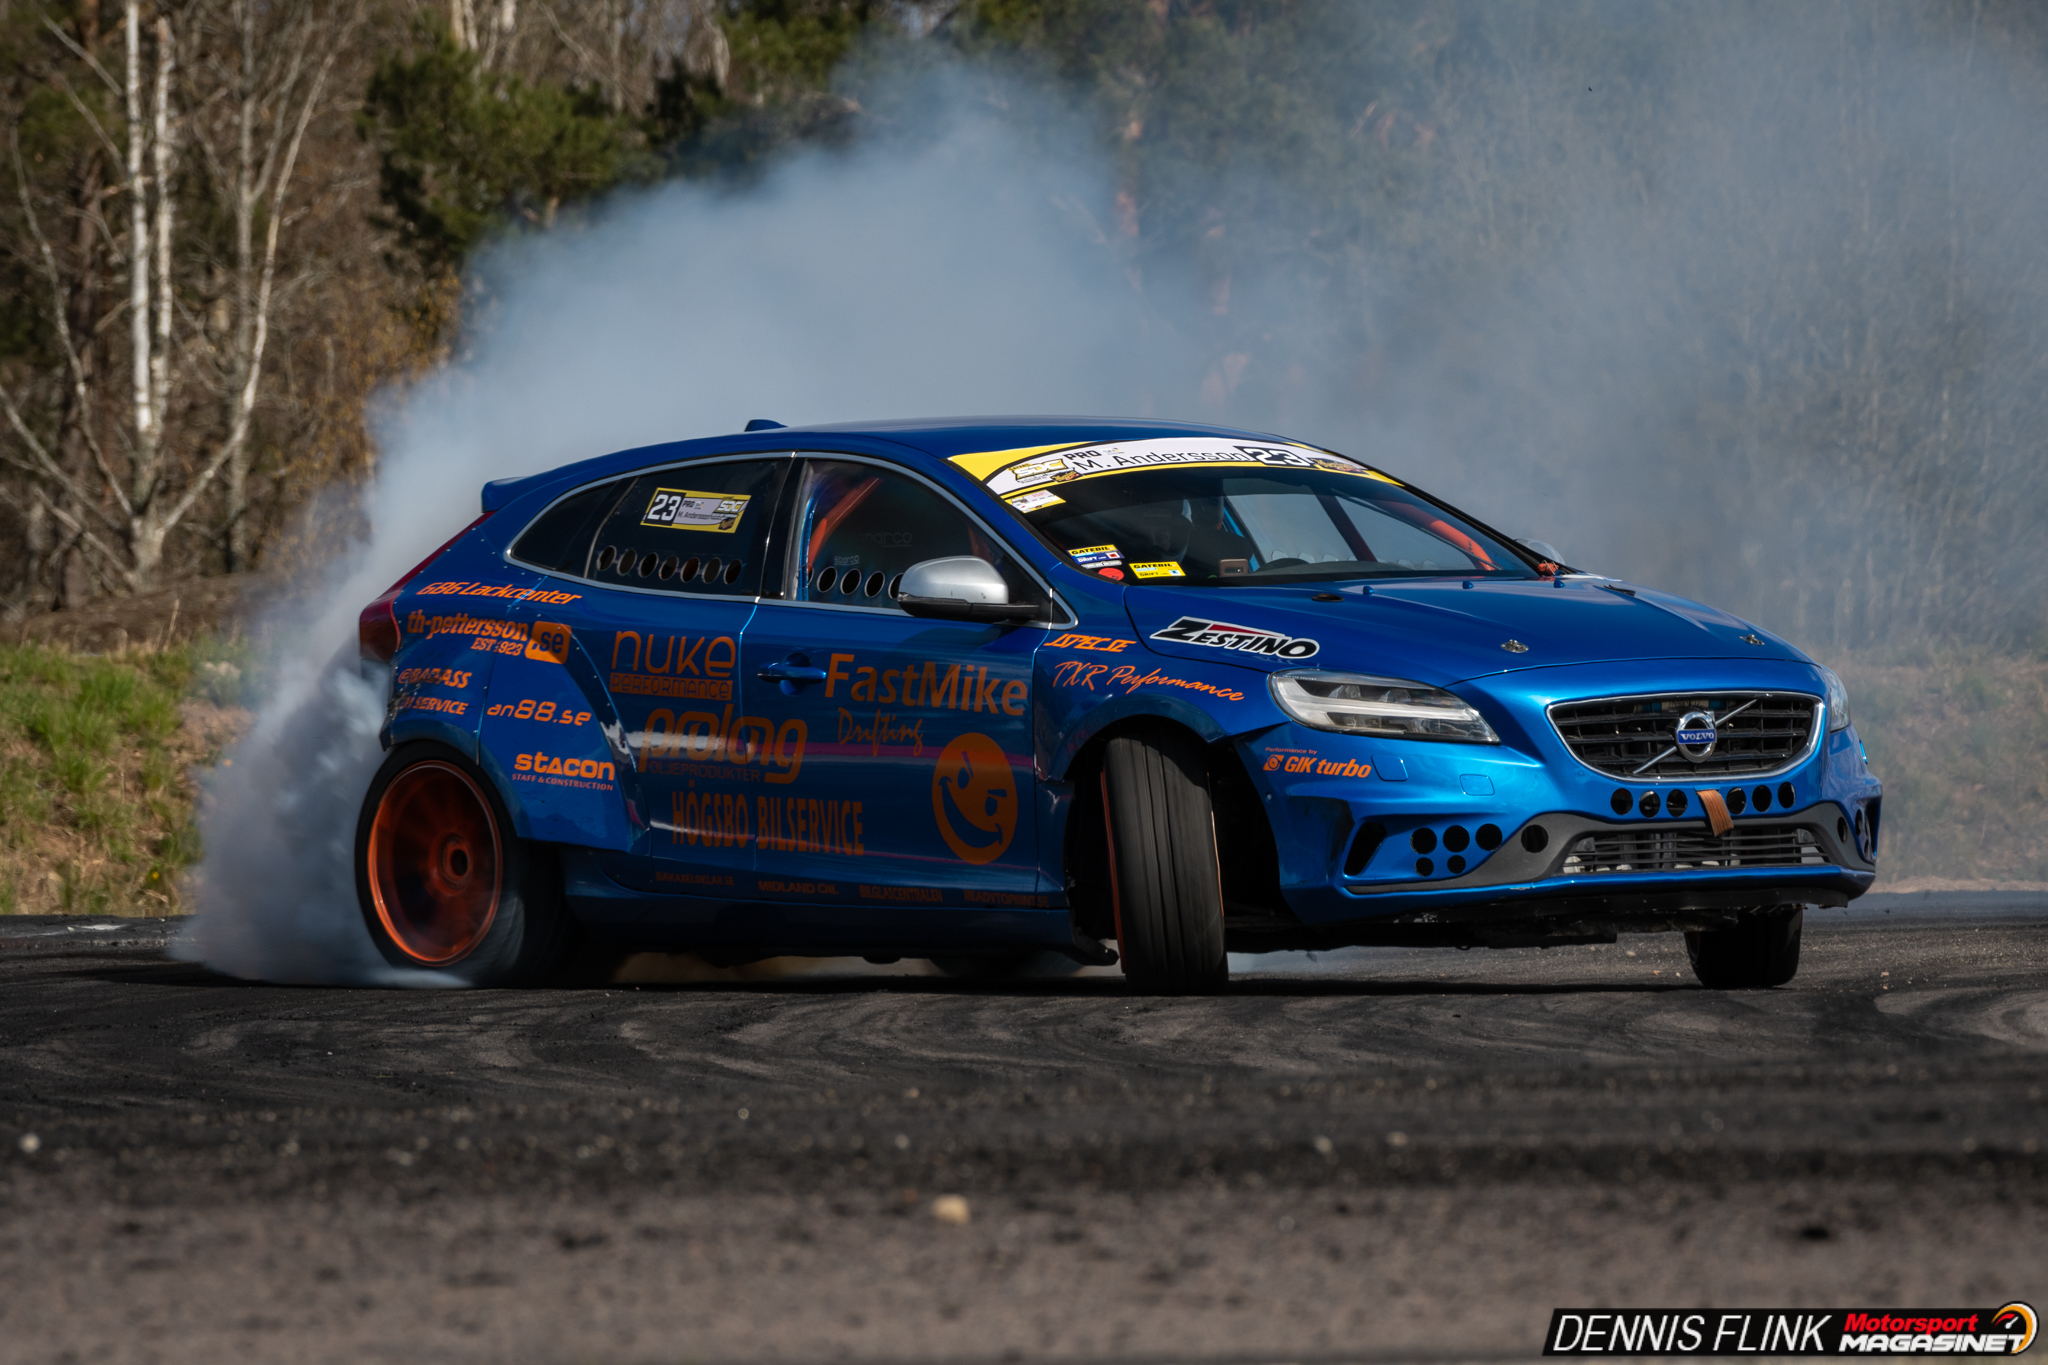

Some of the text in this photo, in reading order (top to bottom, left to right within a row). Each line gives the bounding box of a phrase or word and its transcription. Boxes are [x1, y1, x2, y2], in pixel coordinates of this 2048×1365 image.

[1063, 449, 1102, 461] PRO
[1073, 459, 1112, 471] M.
[1113, 451, 1249, 467] Andersson
[1243, 448, 1311, 467] 23
[1014, 460, 1067, 478] SDC
[647, 493, 682, 521] 23
[716, 500, 744, 512] SDC
[1071, 546, 1110, 555] GATEBIL
[458, 582, 582, 605] Lackcenter
[470, 637, 497, 652] EST
[1150, 616, 1320, 658] ZESTINO
[611, 630, 736, 678] nuke
[825, 653, 1028, 716] FastMike
[1052, 661, 1245, 701] TXR Performance
[412, 696, 469, 715] SERVICE
[487, 698, 592, 727] an88.se
[1680, 732, 1715, 741] VOLVO
[1265, 747, 1307, 755] Performance
[650, 760, 760, 783] OLJEPRODUKTER
[1316, 758, 1372, 778] turbo
[511, 773, 537, 783] STAFF
[545, 775, 614, 791] CONSTRUCTION
[757, 796, 865, 856] BILSERVICE
[757, 880, 840, 895] MIDLAND OIL
